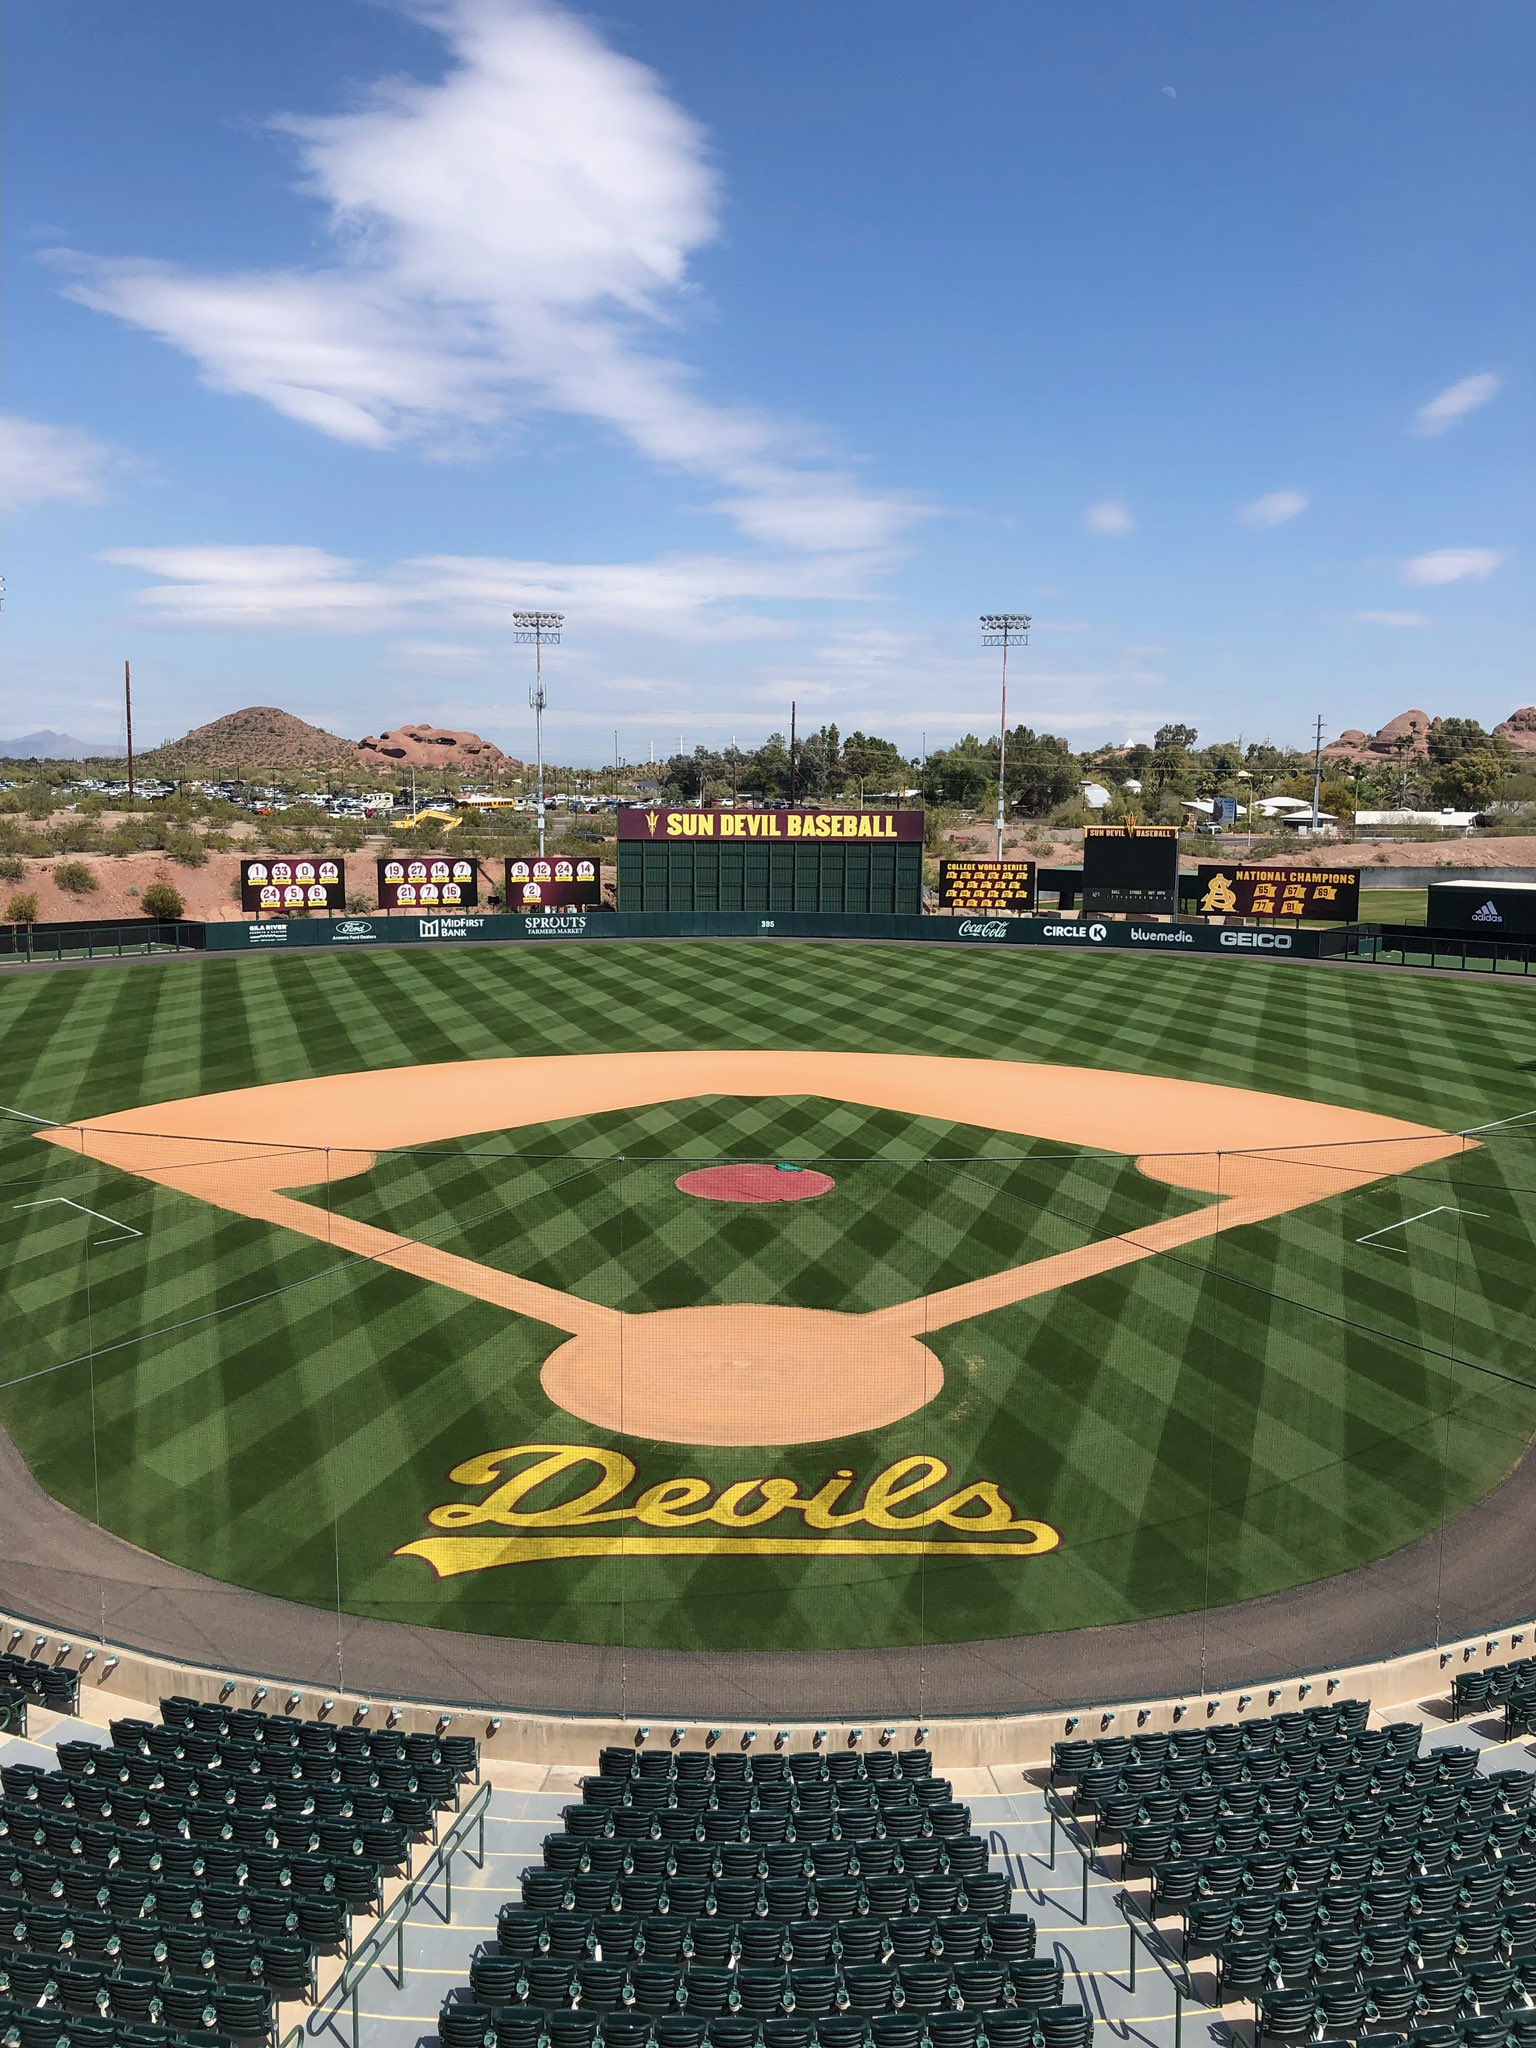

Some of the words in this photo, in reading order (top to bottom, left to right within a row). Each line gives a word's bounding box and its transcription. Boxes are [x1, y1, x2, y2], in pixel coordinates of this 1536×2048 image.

[667, 813, 714, 836] SUN
[720, 814, 781, 836] DEVIL
[787, 815, 897, 837] BASEBALL
[275, 866, 288, 876] 33
[302, 866, 308, 875] 0
[322, 865, 334, 875] 44
[389, 865, 399, 875] 19
[411, 865, 423, 875] 27
[435, 865, 444, 874] 14
[459, 865, 465, 874] 7
[517, 865, 523, 874] 9
[537, 865, 546, 874] 12
[558, 864, 569, 873] 24
[581, 864, 590, 873] 14
[978, 863, 1001, 871] WORLD
[1236, 870, 1286, 882] NATIONAL
[1290, 872, 1355, 884] CHAMPIONS
[263, 889, 276, 899] 24
[291, 888, 297, 898] 5
[314, 888, 320, 897] 6
[401, 887, 411, 897] 21
[426, 887, 432, 896] 7
[447, 886, 456, 895] 16
[529, 885, 535, 894] 2
[1257, 885, 1268, 894] '65
[1286, 886, 1297, 895] '67
[1316, 888, 1328, 897] '69
[1255, 901, 1266, 910] '77
[1284, 902, 1294, 911] '81
[525, 916, 587, 929] SPROUTS
[1471, 913, 1503, 922] adidas
[342, 922, 365, 932] Ford
[761, 920, 775, 928] 395
[958, 920, 1010, 938] Coca-Cola
[441, 928, 467, 937] BANK
[1043, 925, 1087, 938] CIRCLE
[1220, 931, 1292, 949] GEICO
[393, 1443, 1062, 1578] Devils
